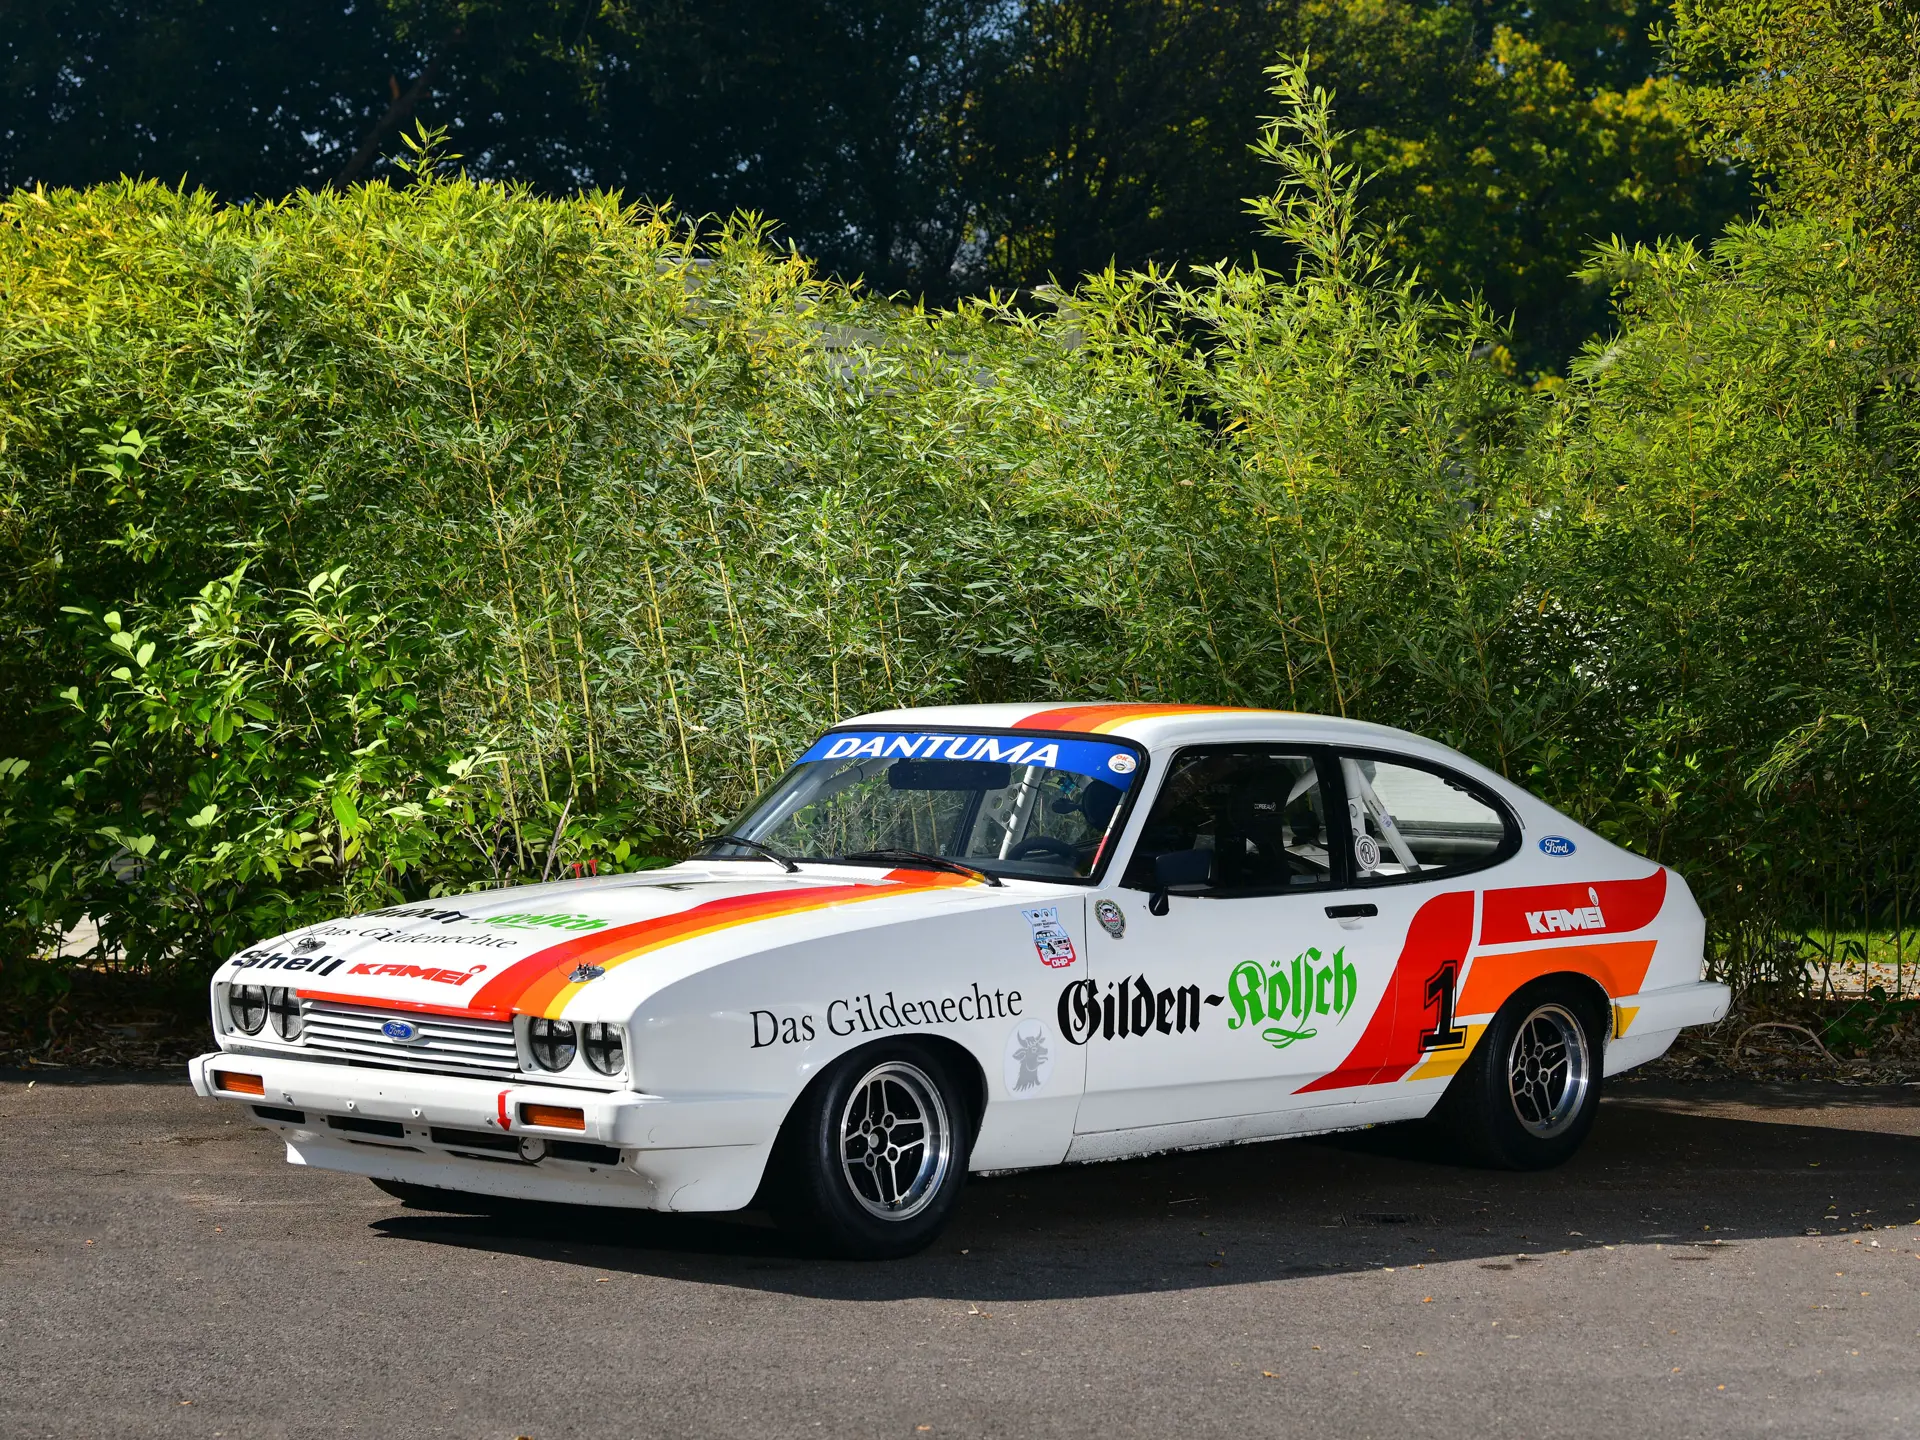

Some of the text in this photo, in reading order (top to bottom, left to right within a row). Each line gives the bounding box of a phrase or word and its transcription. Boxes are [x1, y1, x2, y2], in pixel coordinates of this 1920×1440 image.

[823, 735, 1059, 768] DANTUMA
[1544, 839, 1569, 854] Ford
[359, 927, 518, 949] Gildenechte
[231, 950, 347, 977] Shell
[750, 976, 1022, 1048] Das Gildenechte
[1417, 960, 1468, 1054] 1
[388, 1023, 406, 1037] Ford
